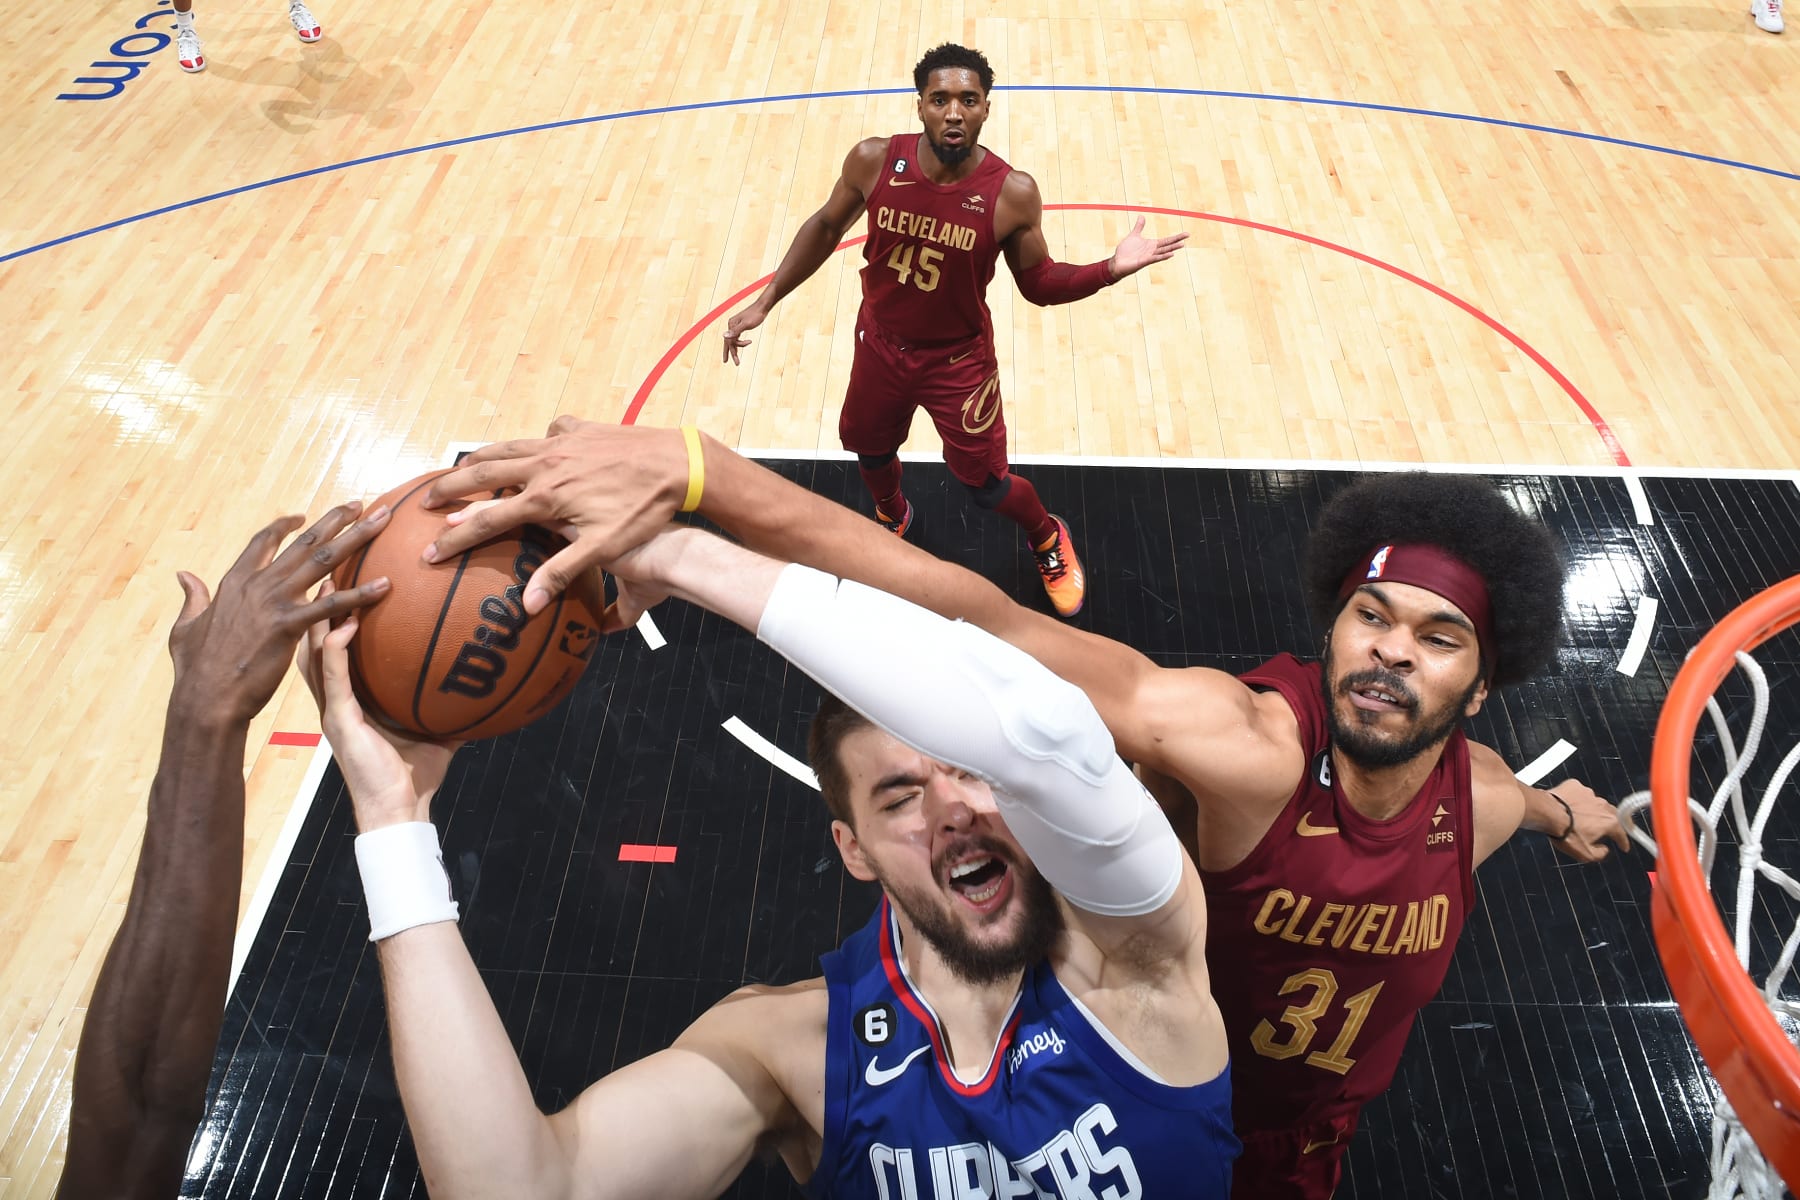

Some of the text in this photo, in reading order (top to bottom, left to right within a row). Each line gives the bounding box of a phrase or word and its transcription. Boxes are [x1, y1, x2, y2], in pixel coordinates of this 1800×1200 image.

[895, 160, 906, 173] 6
[961, 202, 985, 214] CLIFFS
[877, 206, 977, 252] CLEVELAND
[887, 242, 945, 292] 45
[1426, 831, 1454, 846] CLIFFS
[1254, 888, 1450, 955] CLEVELAND
[865, 1008, 888, 1042] 6
[1250, 967, 1385, 1075] 31
